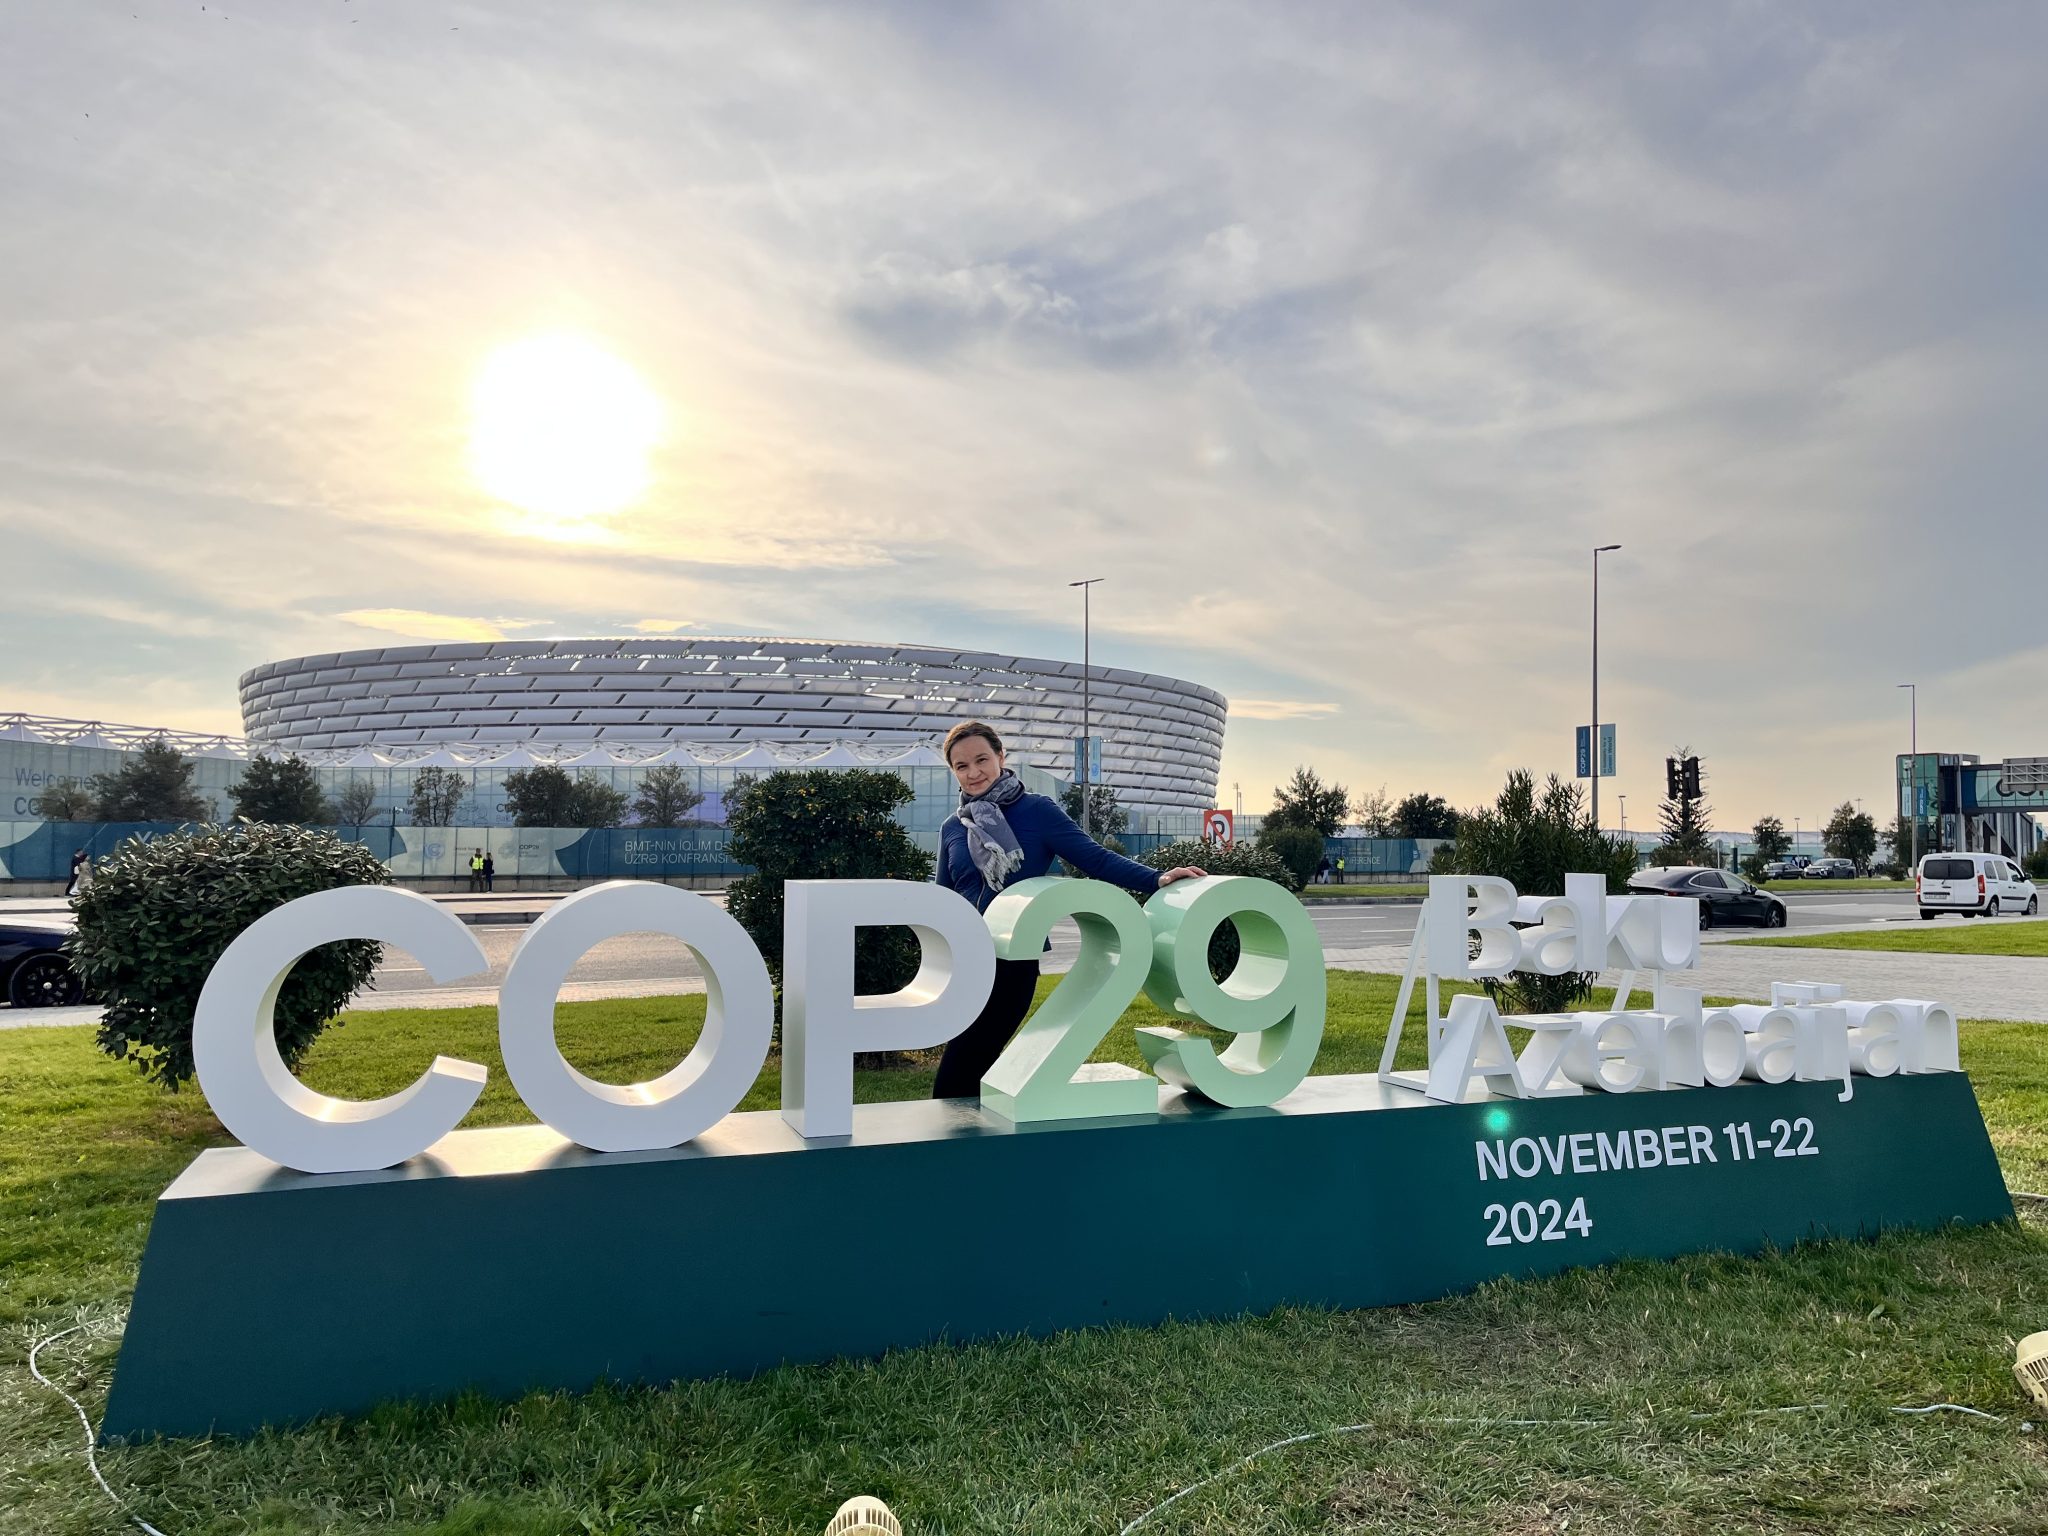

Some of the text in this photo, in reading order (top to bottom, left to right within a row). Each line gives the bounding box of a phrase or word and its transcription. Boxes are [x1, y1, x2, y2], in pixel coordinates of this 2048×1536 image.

[15, 768, 95, 790] Welcome
[1428, 872, 1700, 977] Baku
[192, 876, 1327, 1174] COP29
[1425, 980, 1961, 1103] Azerbaijan
[1475, 1117, 1819, 1181] NOVEMBER 11-22
[1483, 1197, 1593, 1246] 2024
